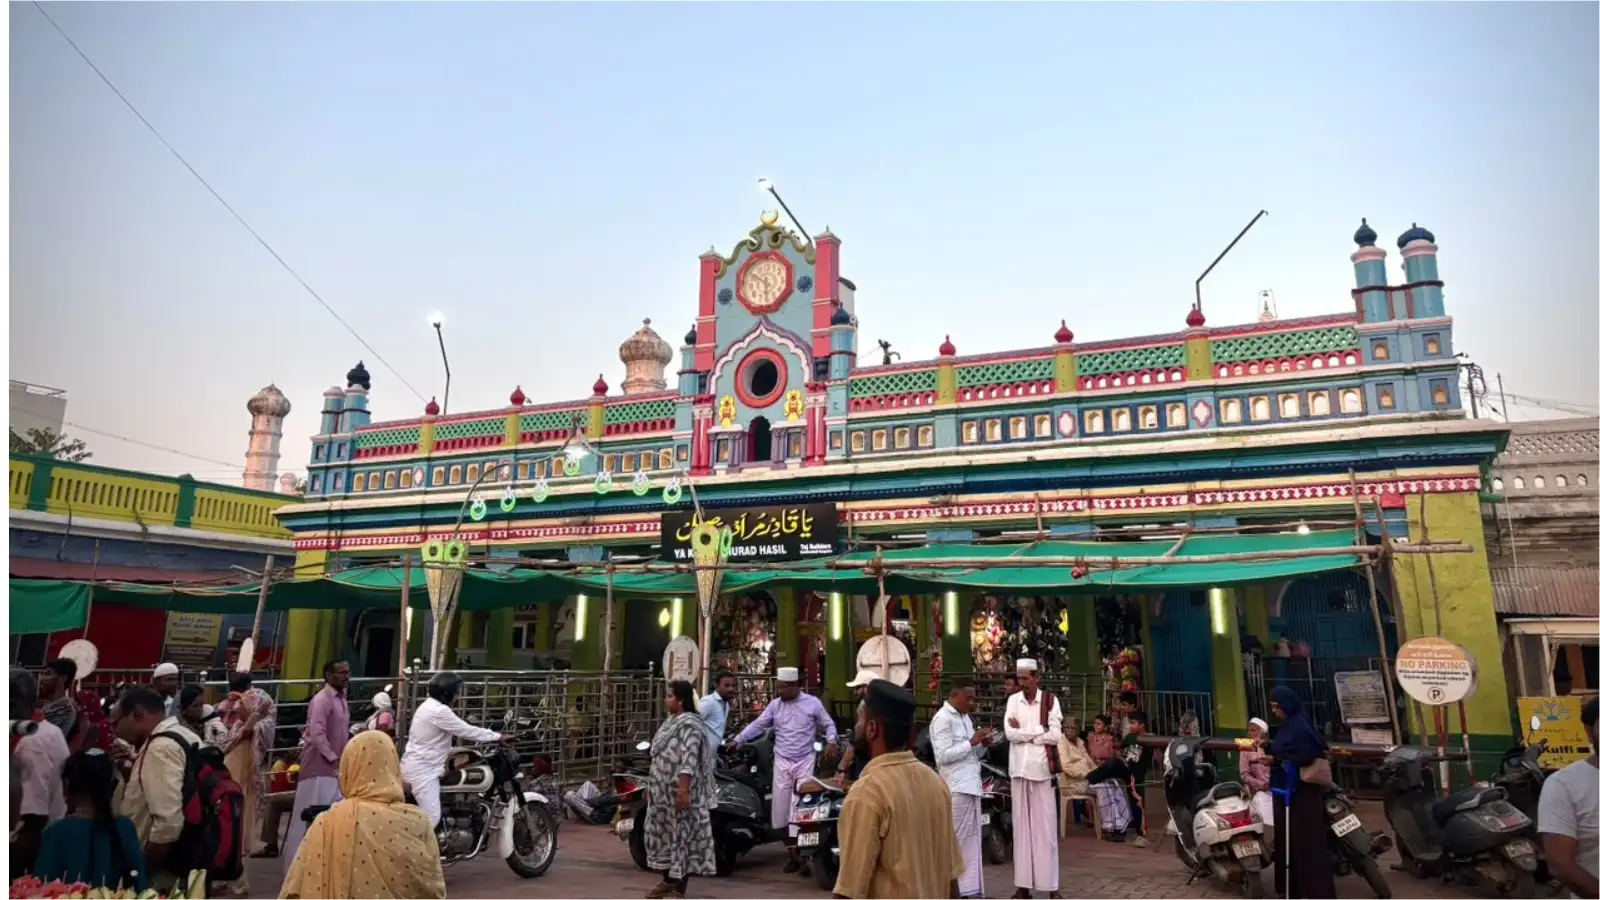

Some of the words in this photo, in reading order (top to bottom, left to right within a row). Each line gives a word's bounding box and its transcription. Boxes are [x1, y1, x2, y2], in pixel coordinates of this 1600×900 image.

[674, 548, 686, 559] YA
[759, 543, 787, 556] HASIL
[1399, 660, 1415, 669] NO
[1418, 660, 1467, 670] PARKING
